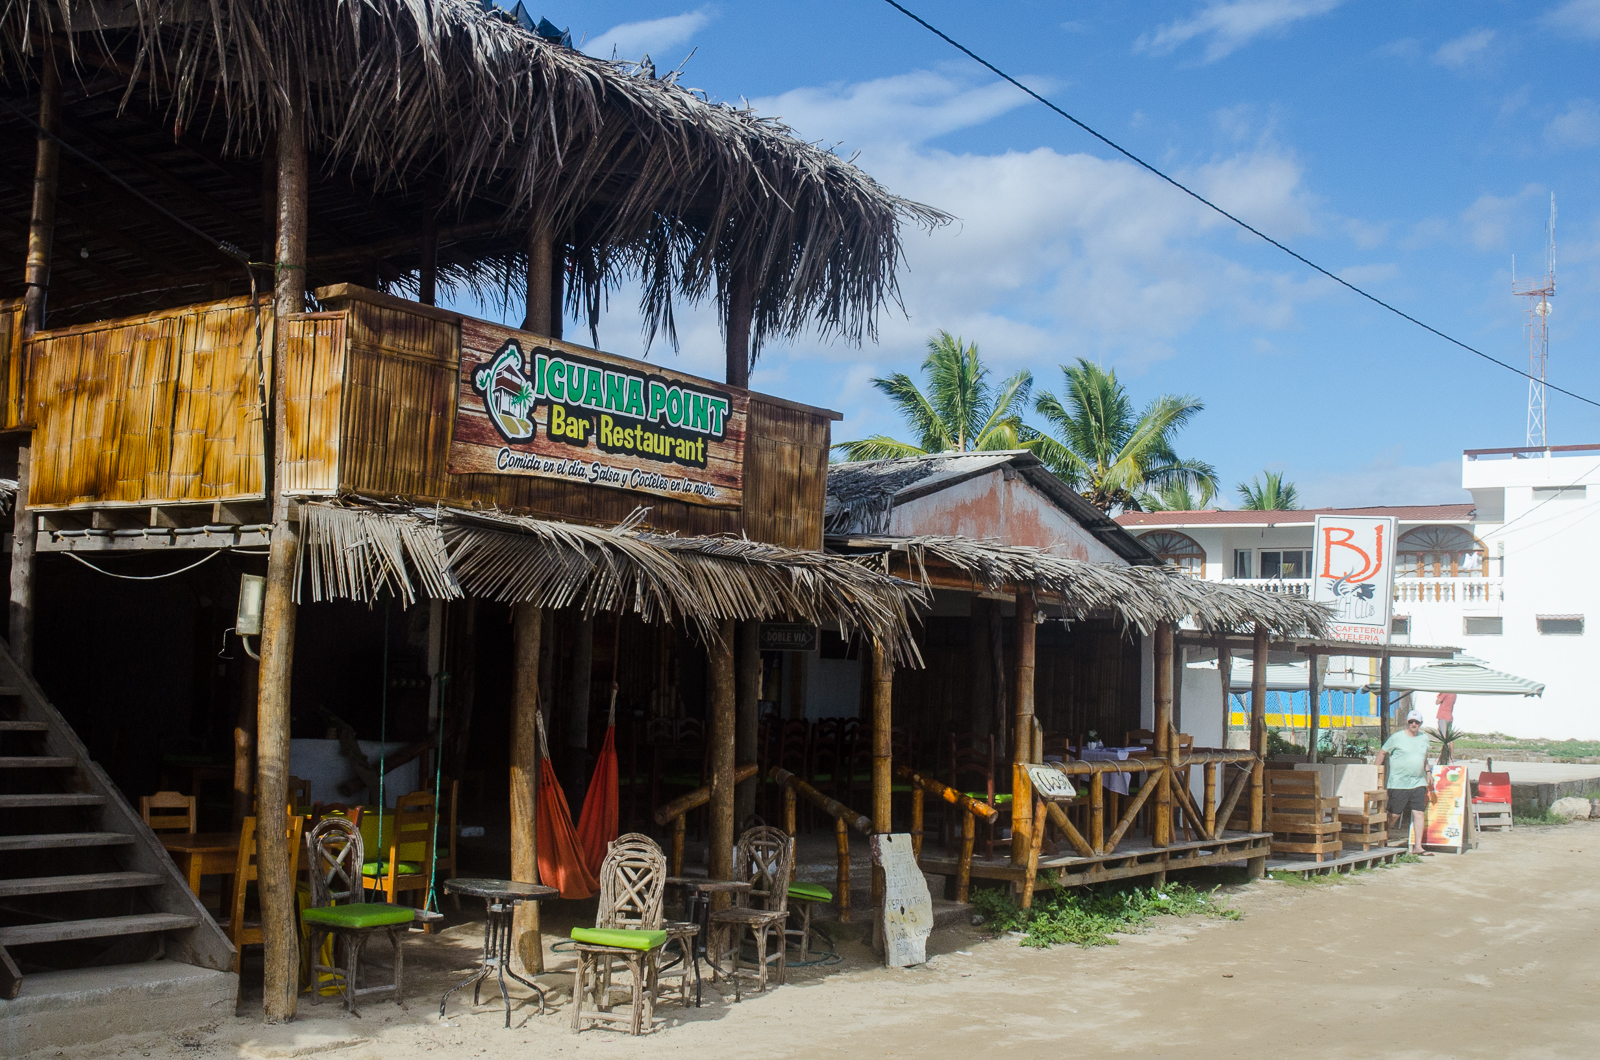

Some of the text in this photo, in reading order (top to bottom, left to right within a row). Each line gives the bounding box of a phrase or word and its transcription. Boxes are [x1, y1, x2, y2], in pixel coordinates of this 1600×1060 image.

[535, 354, 729, 436] IGUANA POINT
[551, 405, 704, 463] Bar Restaurant
[498, 448, 541, 470] Comida
[543, 460, 555, 473] en
[556, 460, 567, 475] el
[588, 462, 620, 483] Salsa
[620, 473, 628, 487] y
[629, 468, 669, 490] Cocteles
[670, 479, 681, 492] en
[682, 478, 693, 493] la
[693, 482, 717, 497] noche
[1320, 524, 1384, 583] BJ
[767, 631, 807, 643] DOBLE VIA
